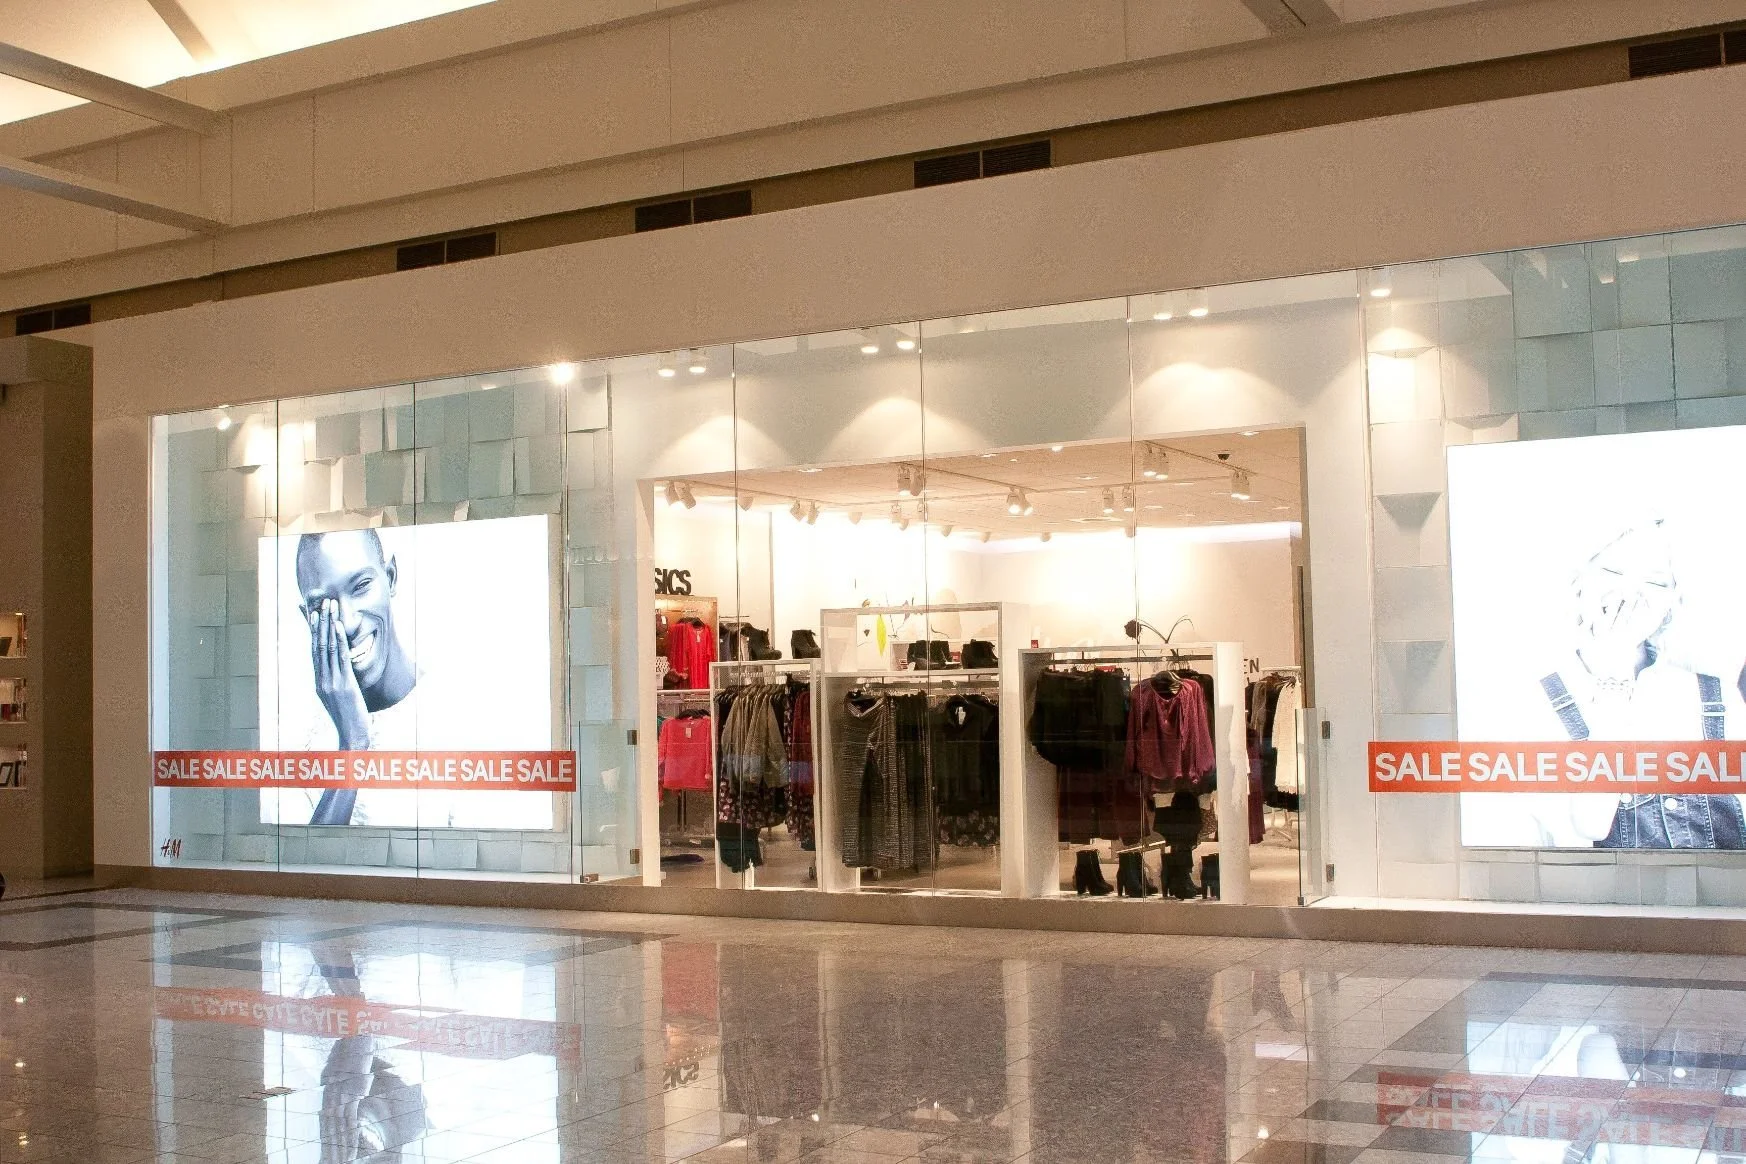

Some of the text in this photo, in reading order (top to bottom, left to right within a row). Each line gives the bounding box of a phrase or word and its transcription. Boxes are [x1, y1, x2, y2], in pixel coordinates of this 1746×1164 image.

[158, 758, 573, 783] SALE SALE SALE SALE SALE SALE SALE SALE
[1375, 751, 1746, 782] SALE SALE SALE SAL
